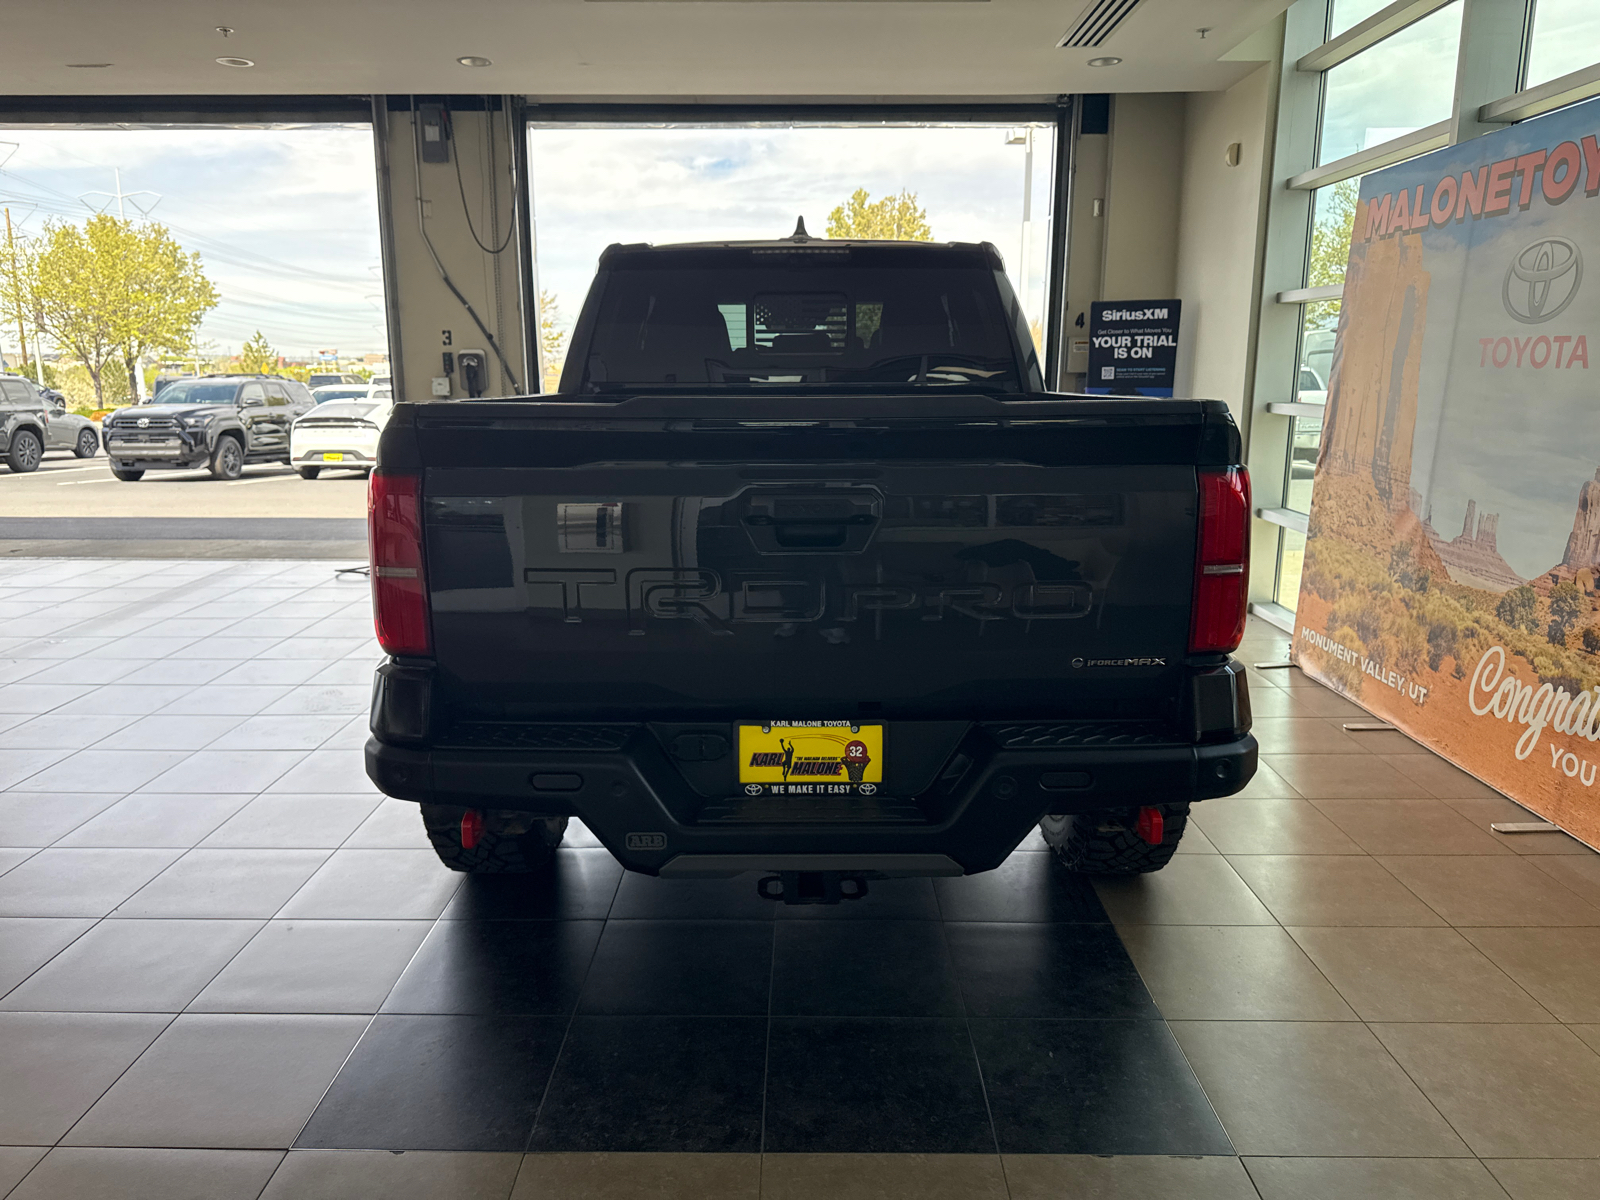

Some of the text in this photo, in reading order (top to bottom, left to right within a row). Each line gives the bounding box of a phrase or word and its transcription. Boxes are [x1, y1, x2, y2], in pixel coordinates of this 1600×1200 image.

[1075, 312, 1085, 328] 4
[1102, 308, 1168, 321] SiriusXM
[442, 330, 452, 346] 3
[1092, 335, 1177, 348] YOUR TRIAL
[1114, 347, 1153, 359] IS ON
[1479, 335, 1589, 370] TOYOTA
[523, 568, 1094, 635] TRD PRO
[1301, 626, 1428, 704] MONUMENT VALLEY, UT
[849, 746, 863, 757] 32
[749, 752, 785, 767] KARL
[1550, 743, 1597, 787] YOU
[790, 761, 843, 776] MALONE
[771, 785, 850, 794] WE MAKE IT EASY
[630, 835, 664, 847] ARB
